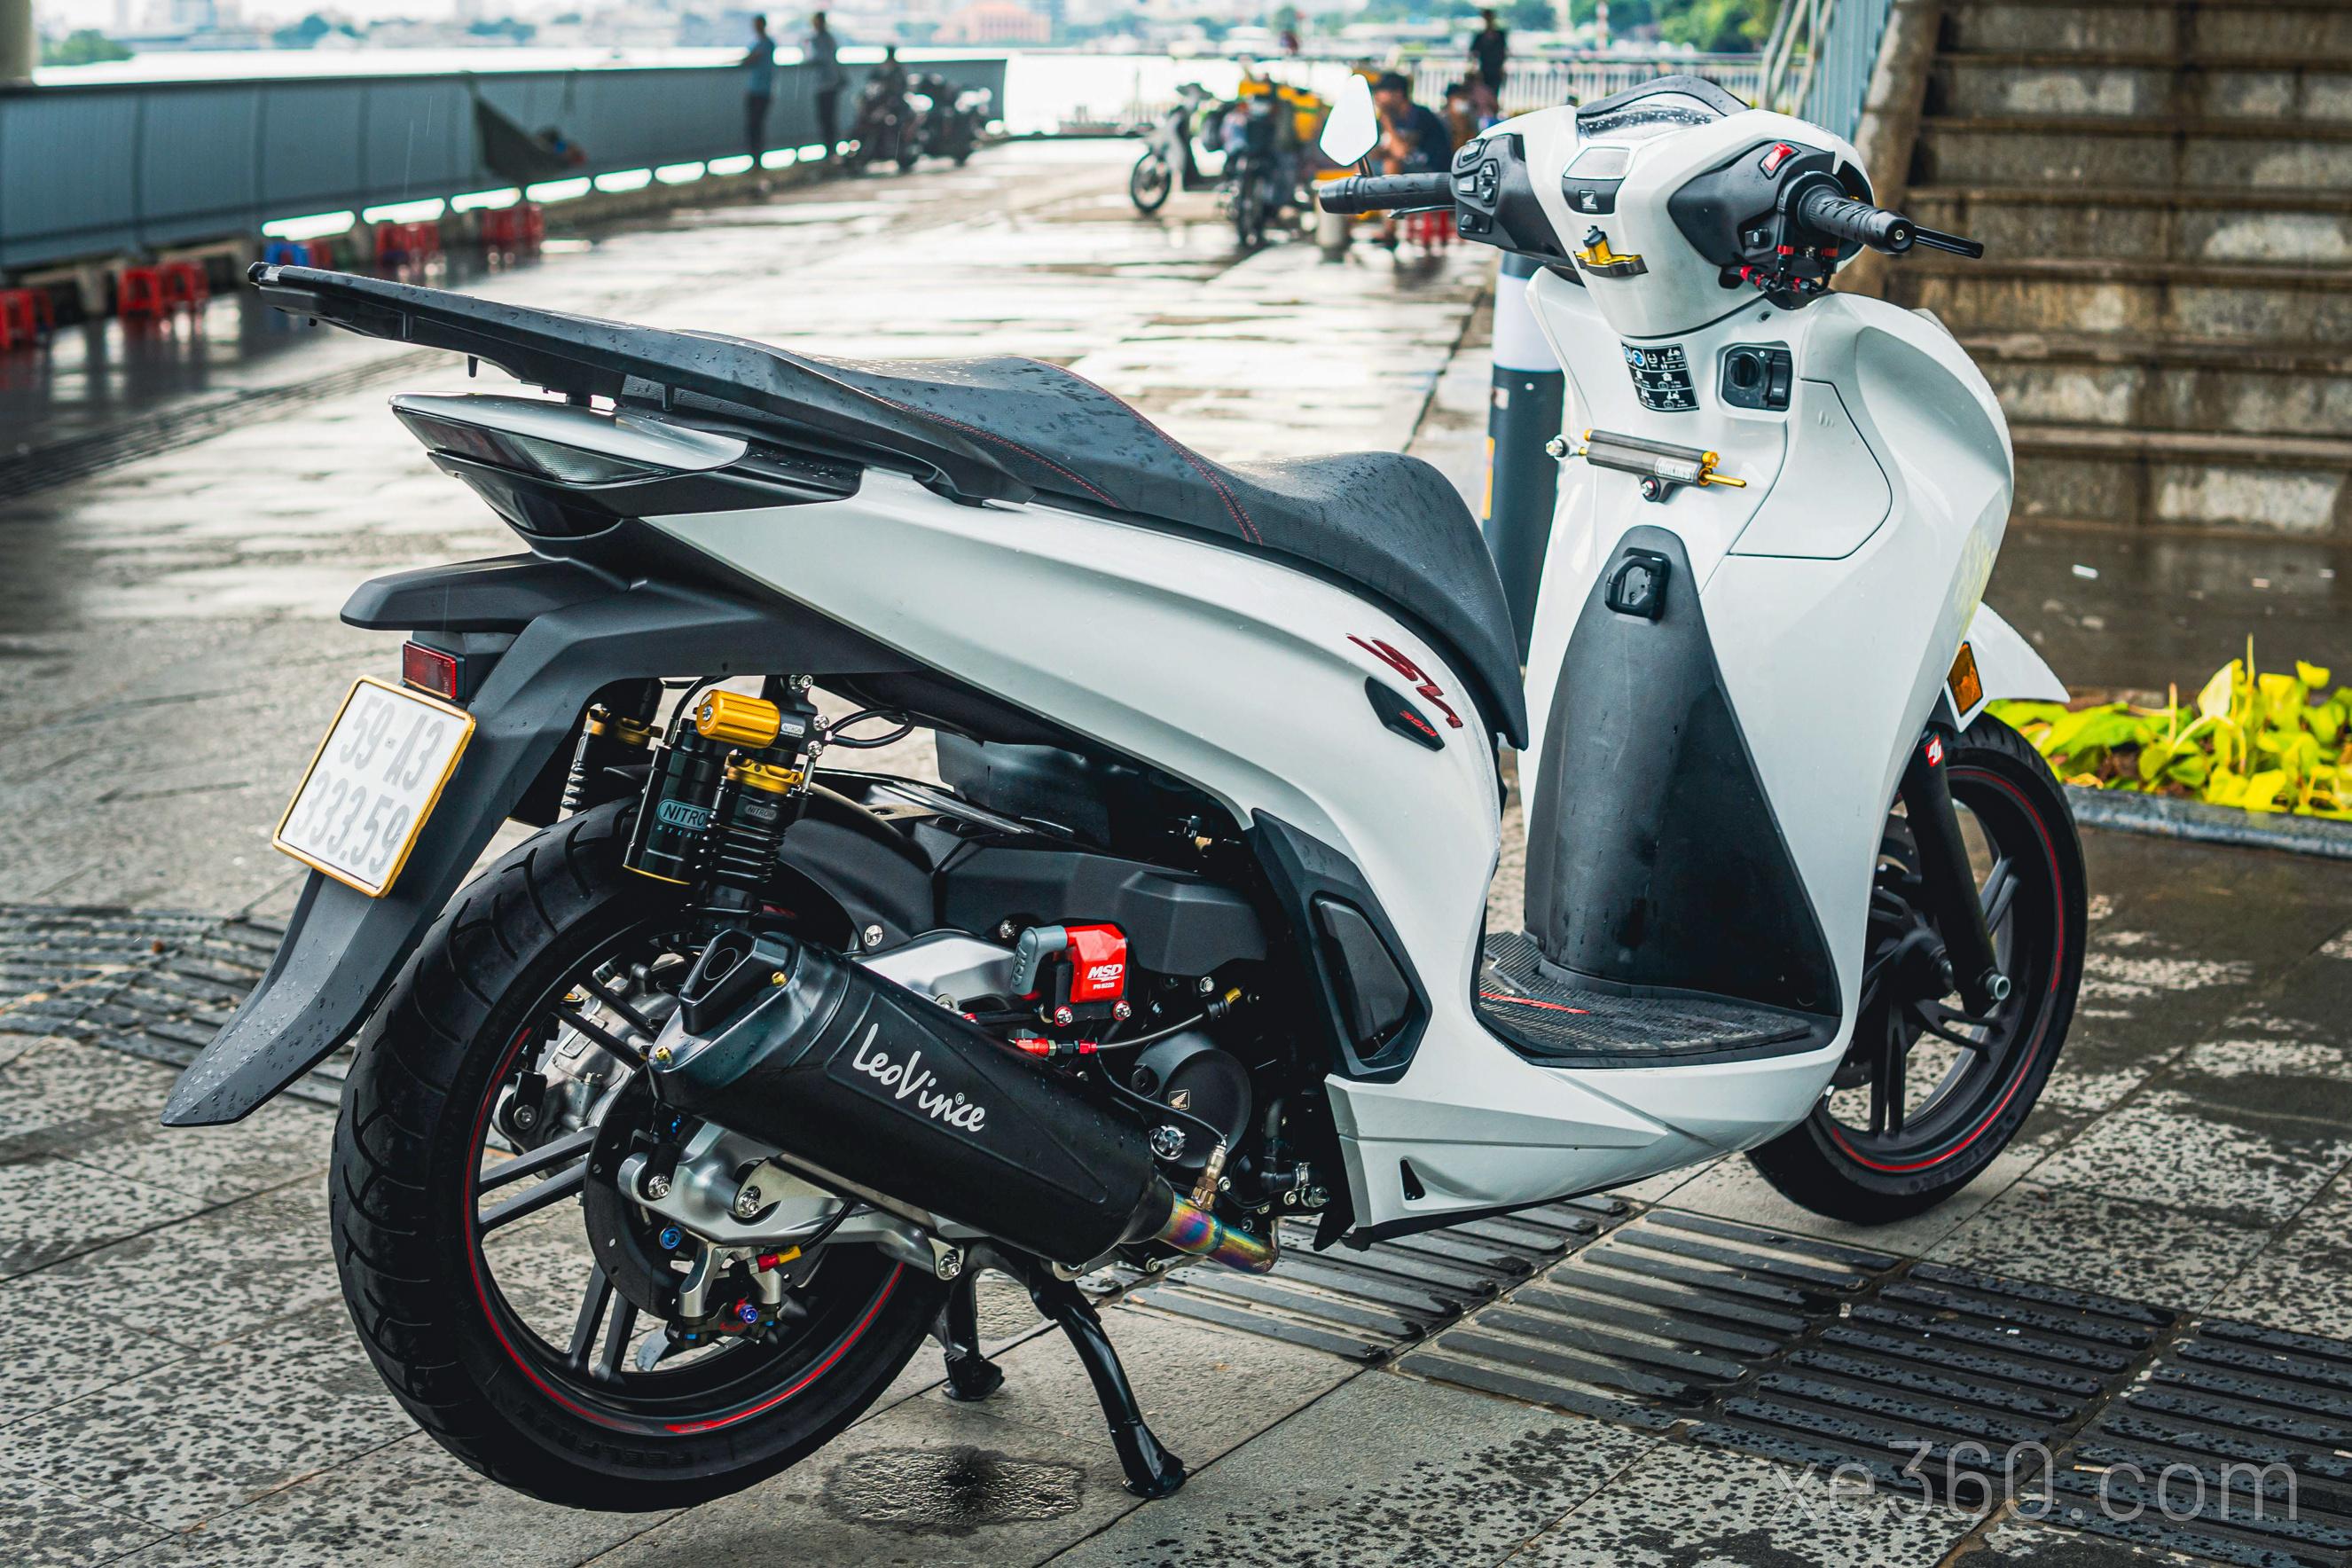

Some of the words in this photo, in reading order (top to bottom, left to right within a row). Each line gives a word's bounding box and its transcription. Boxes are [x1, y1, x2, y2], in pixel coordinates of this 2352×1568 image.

[340, 695, 445, 791] 59-A3
[291, 770, 411, 874] 333.59
[662, 803, 707, 827] NITRO
[1087, 963, 1124, 980] MSD
